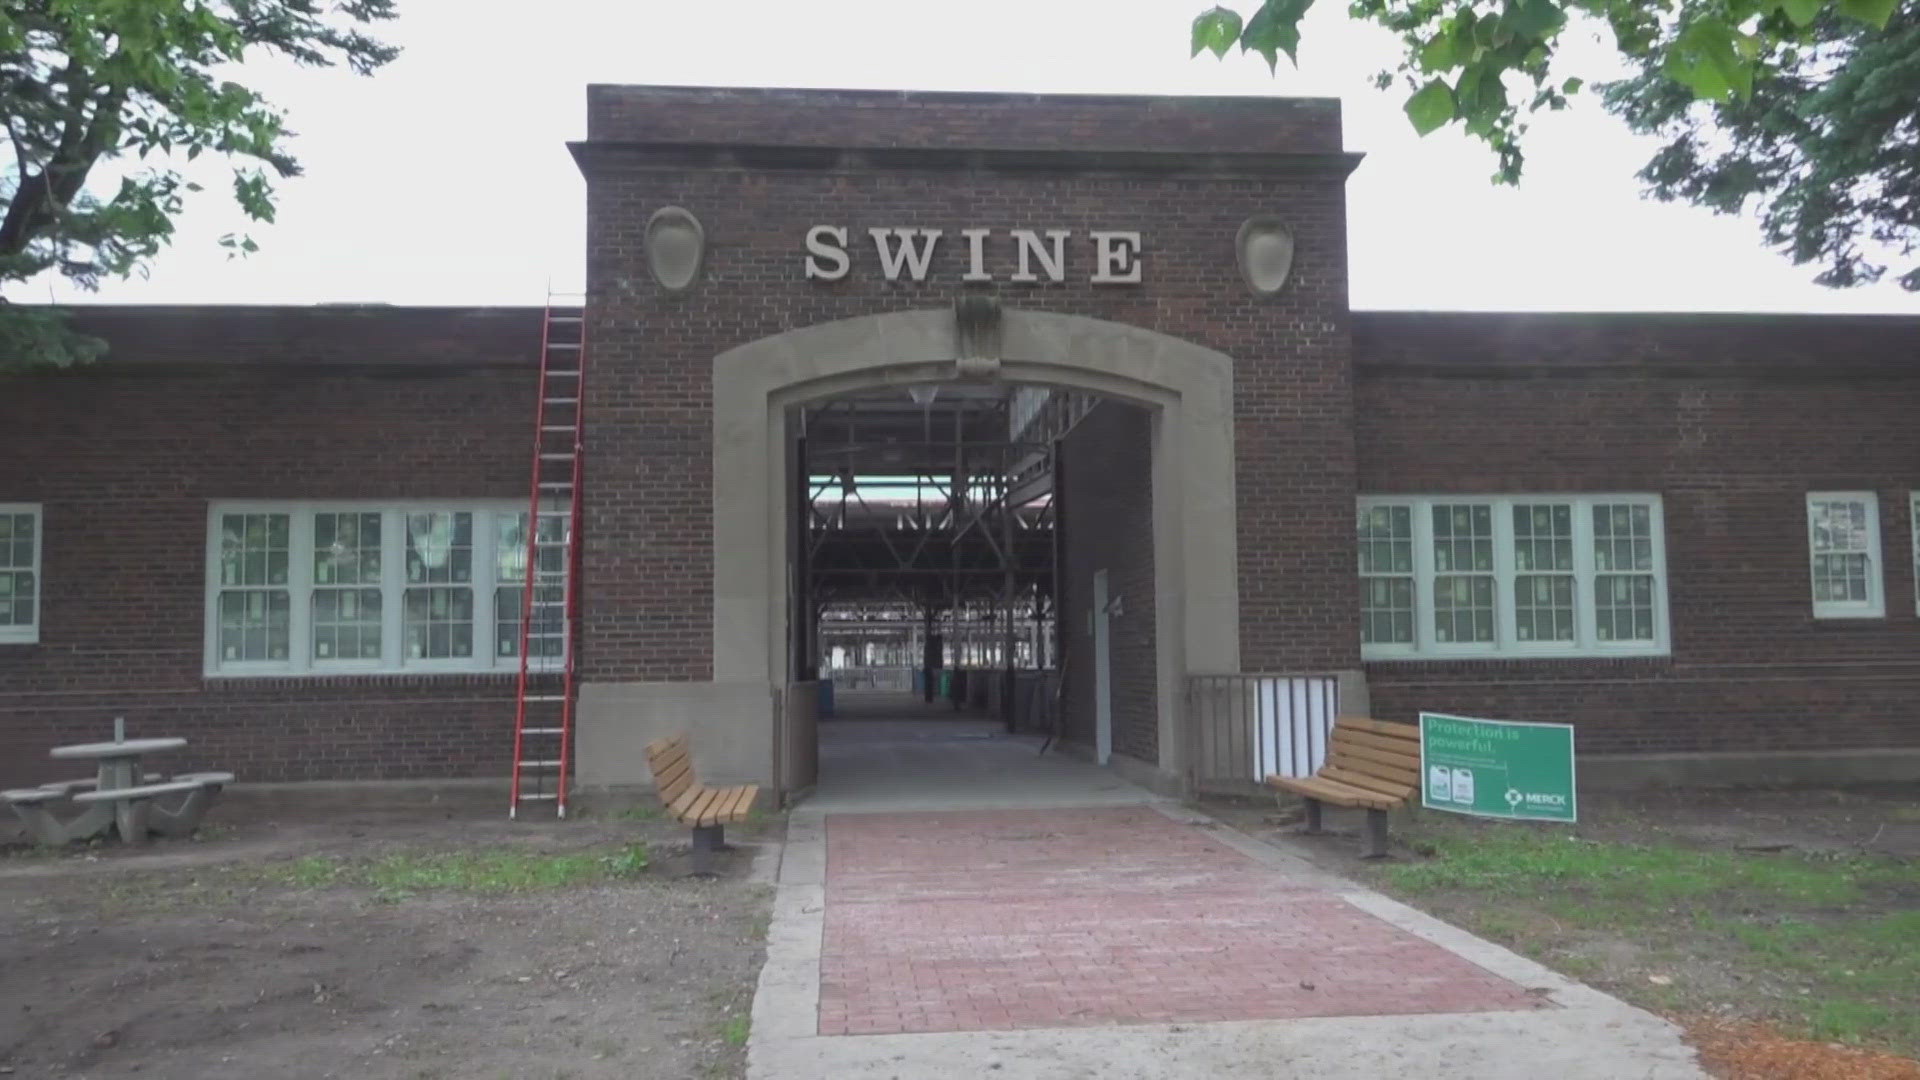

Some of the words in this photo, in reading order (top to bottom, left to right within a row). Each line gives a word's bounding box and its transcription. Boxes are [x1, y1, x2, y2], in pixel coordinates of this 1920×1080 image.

[805, 225, 1142, 283] SWINE
[1428, 719, 1503, 740] Protection
[1507, 728, 1520, 740] is
[1429, 736, 1496, 753] powerful.
[1526, 793, 1566, 805] MERCK
